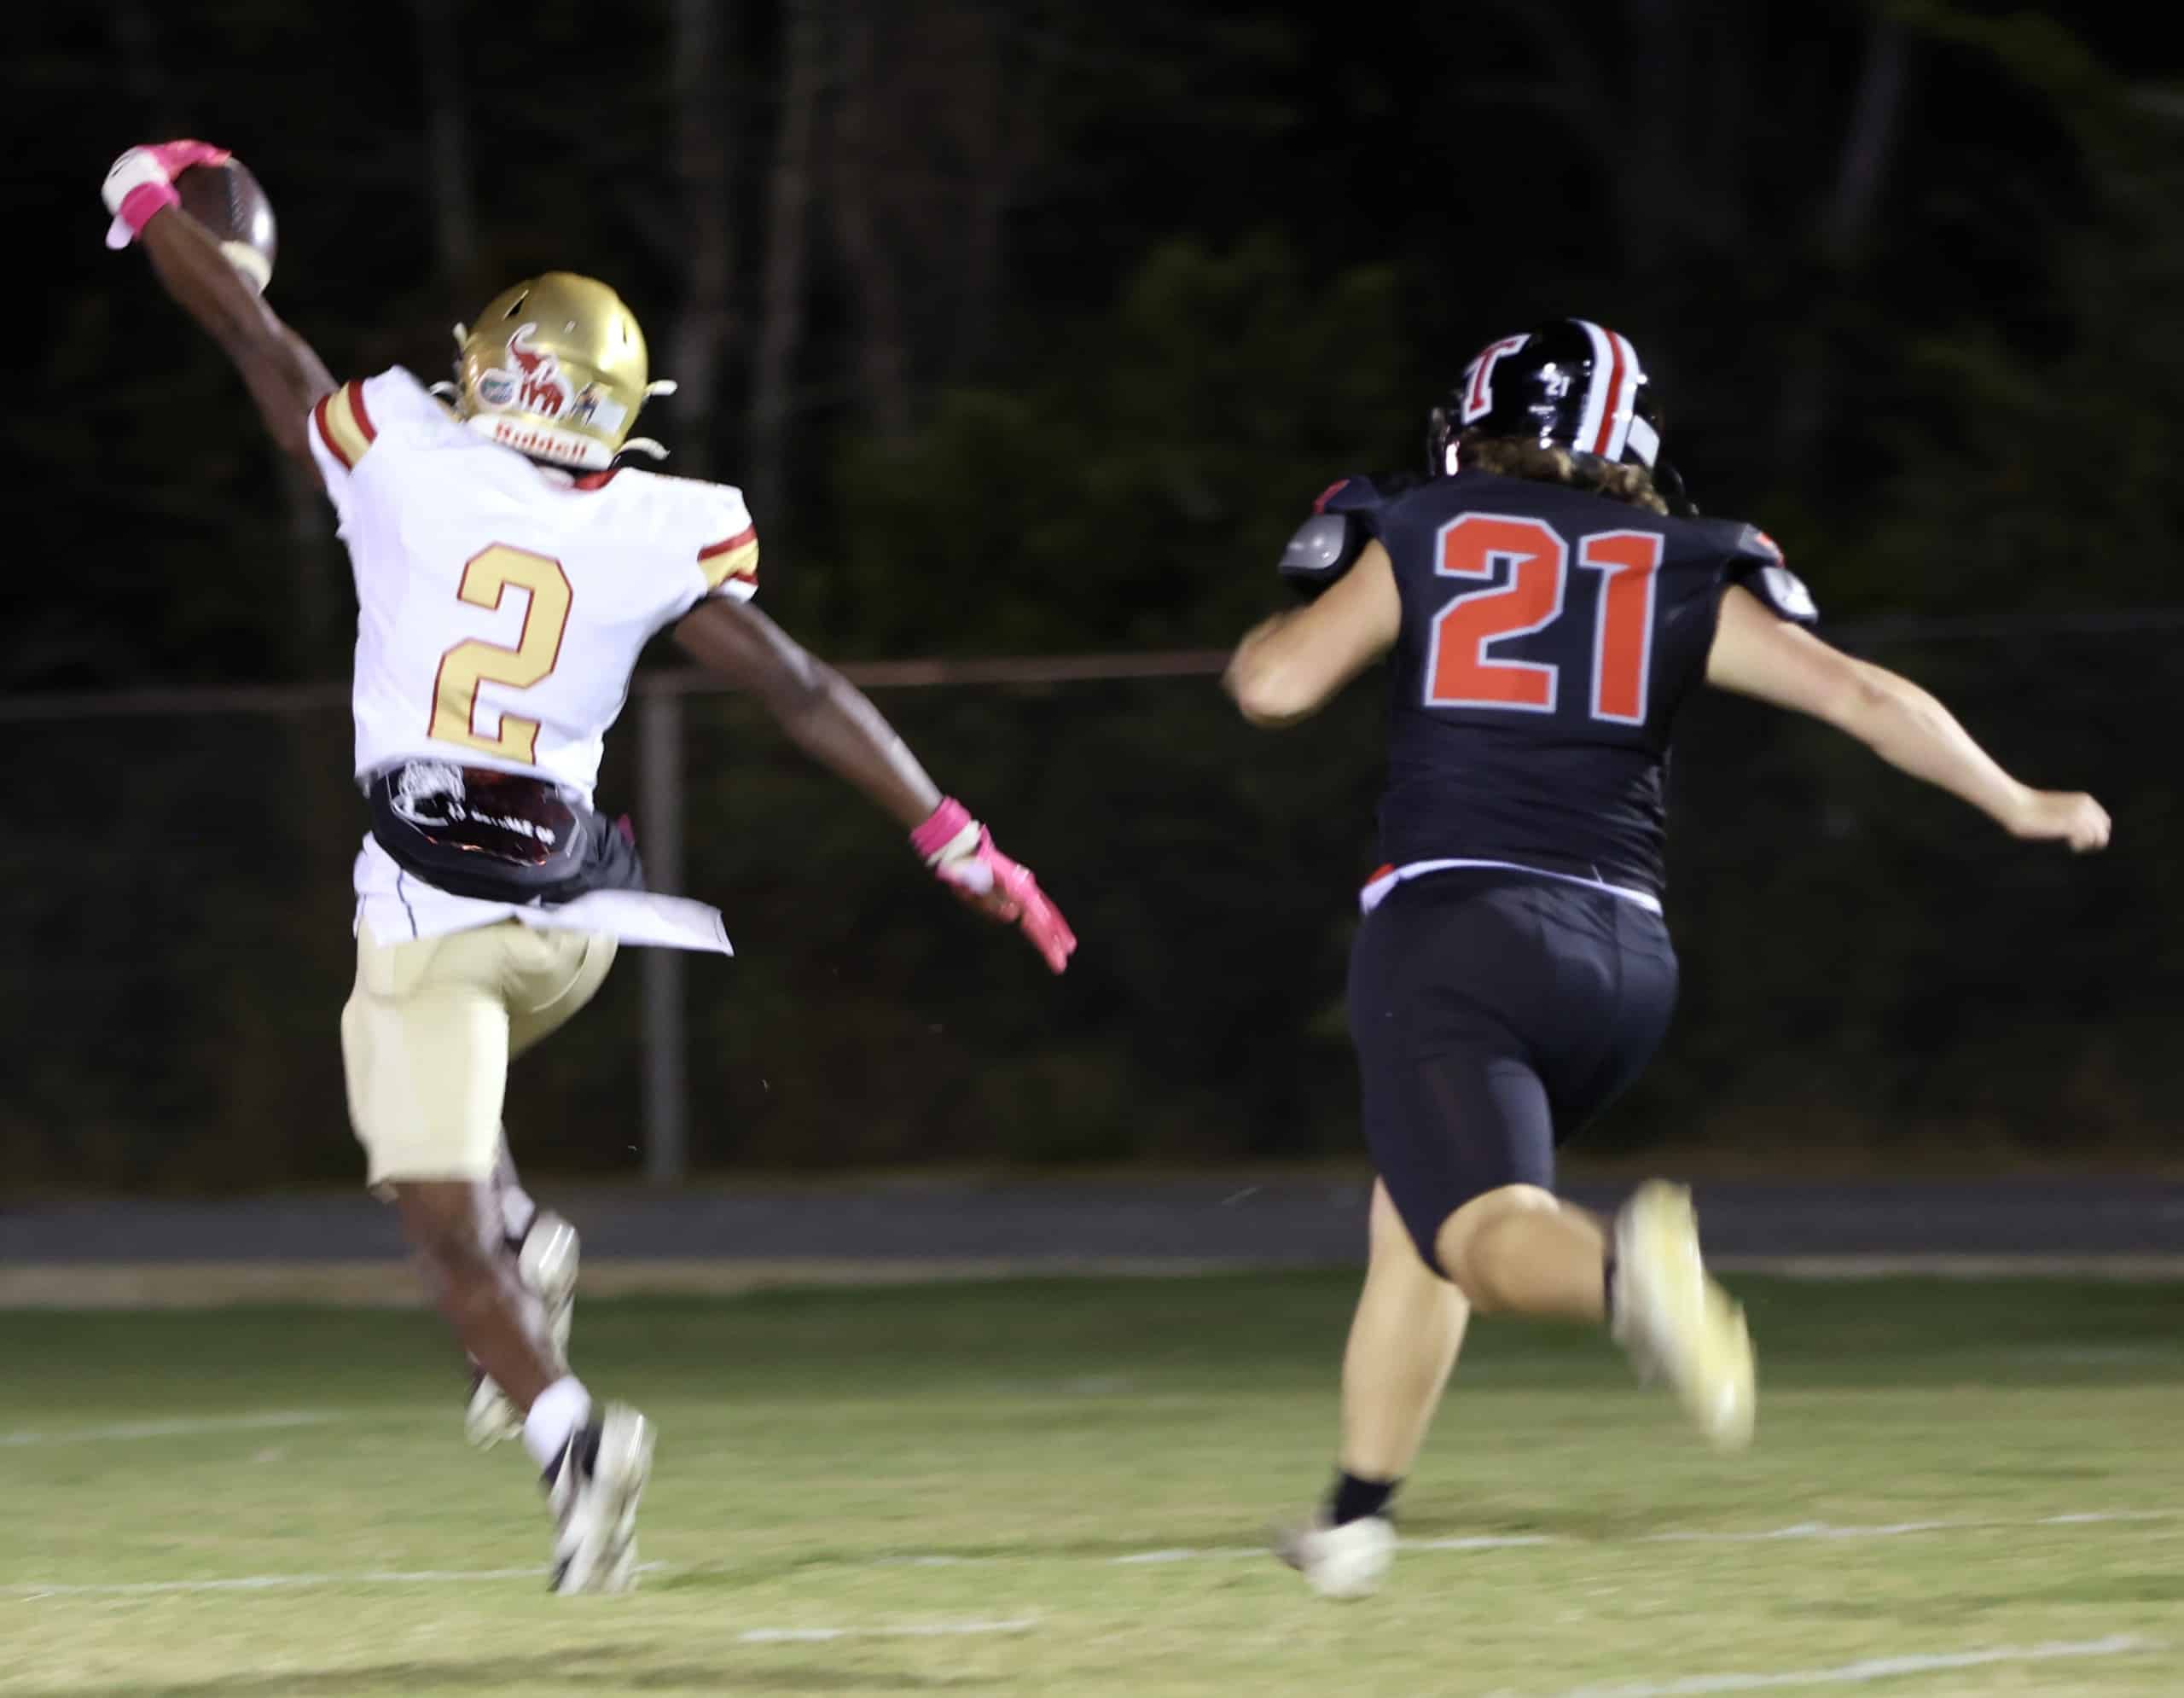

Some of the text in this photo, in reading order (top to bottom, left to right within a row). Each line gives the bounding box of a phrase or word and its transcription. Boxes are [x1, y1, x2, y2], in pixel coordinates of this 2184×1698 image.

[1462, 334, 1531, 425] T
[1545, 375, 1571, 398] 21
[427, 541, 573, 765] 2
[1424, 511, 1664, 726] 21
